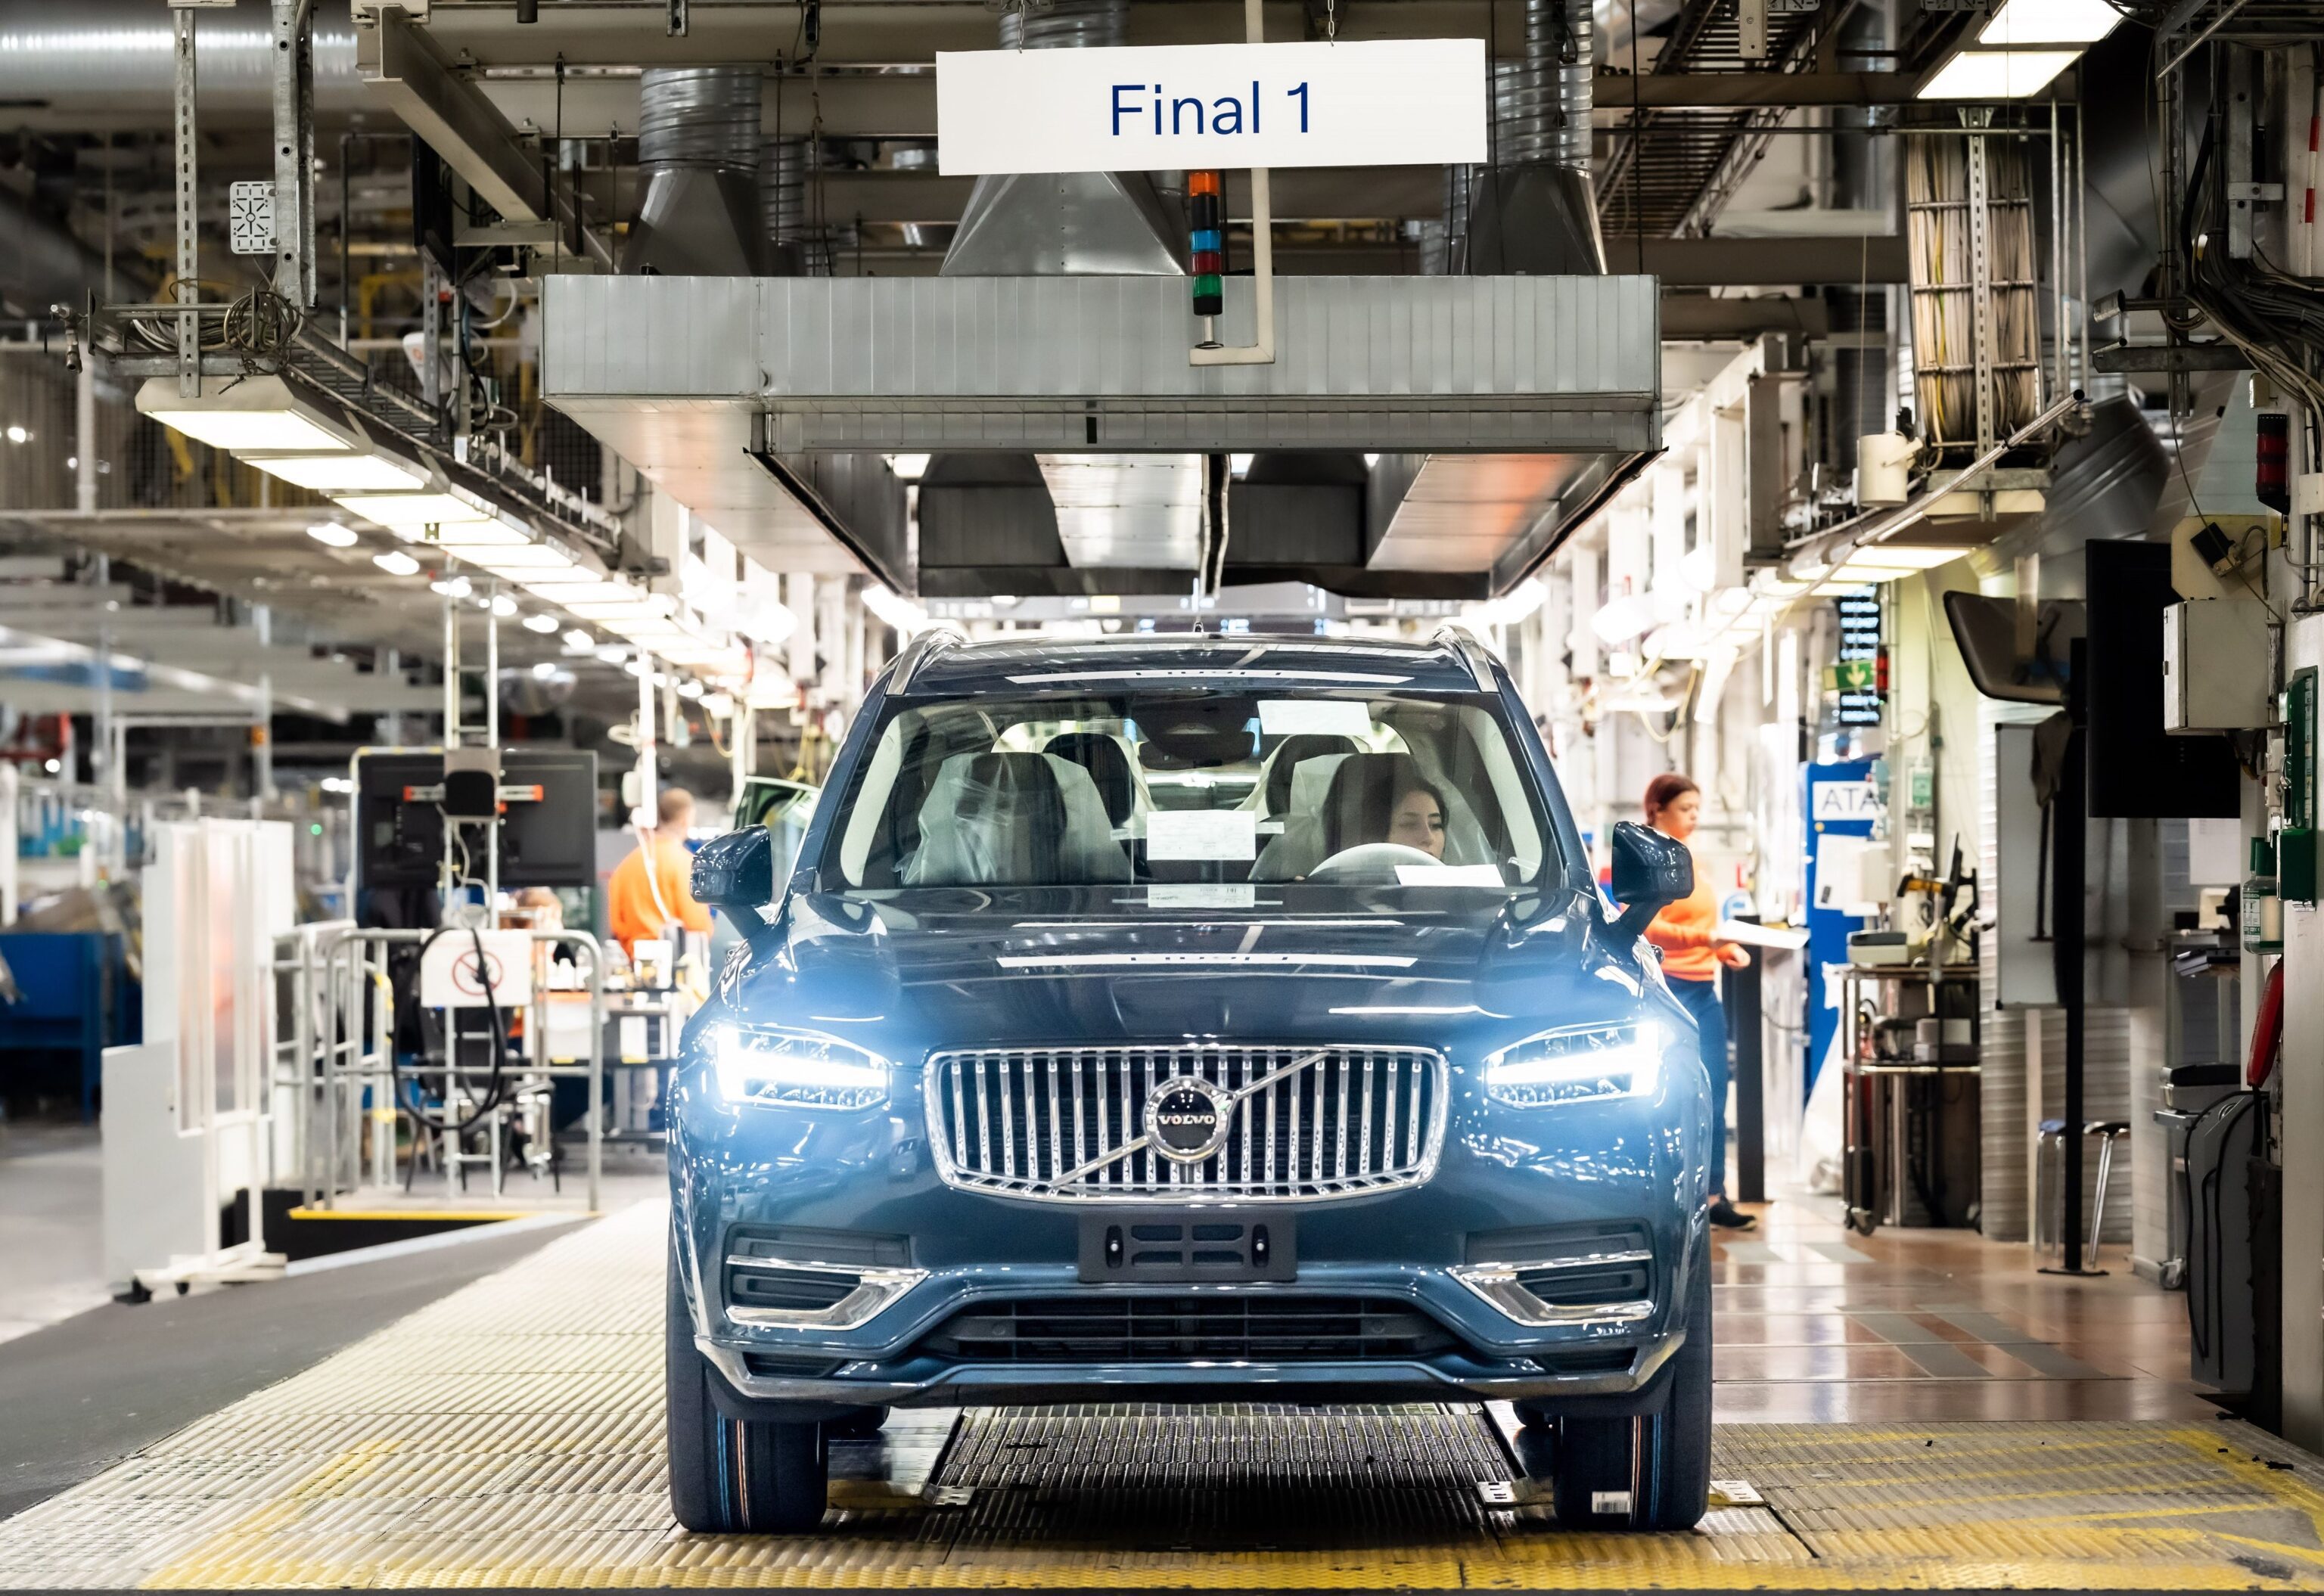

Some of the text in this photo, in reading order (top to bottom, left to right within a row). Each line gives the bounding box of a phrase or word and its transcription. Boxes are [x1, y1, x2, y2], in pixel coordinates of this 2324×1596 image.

[1112, 81, 1308, 136] Final 1
[1157, 1115, 1215, 1125] VOLVO
